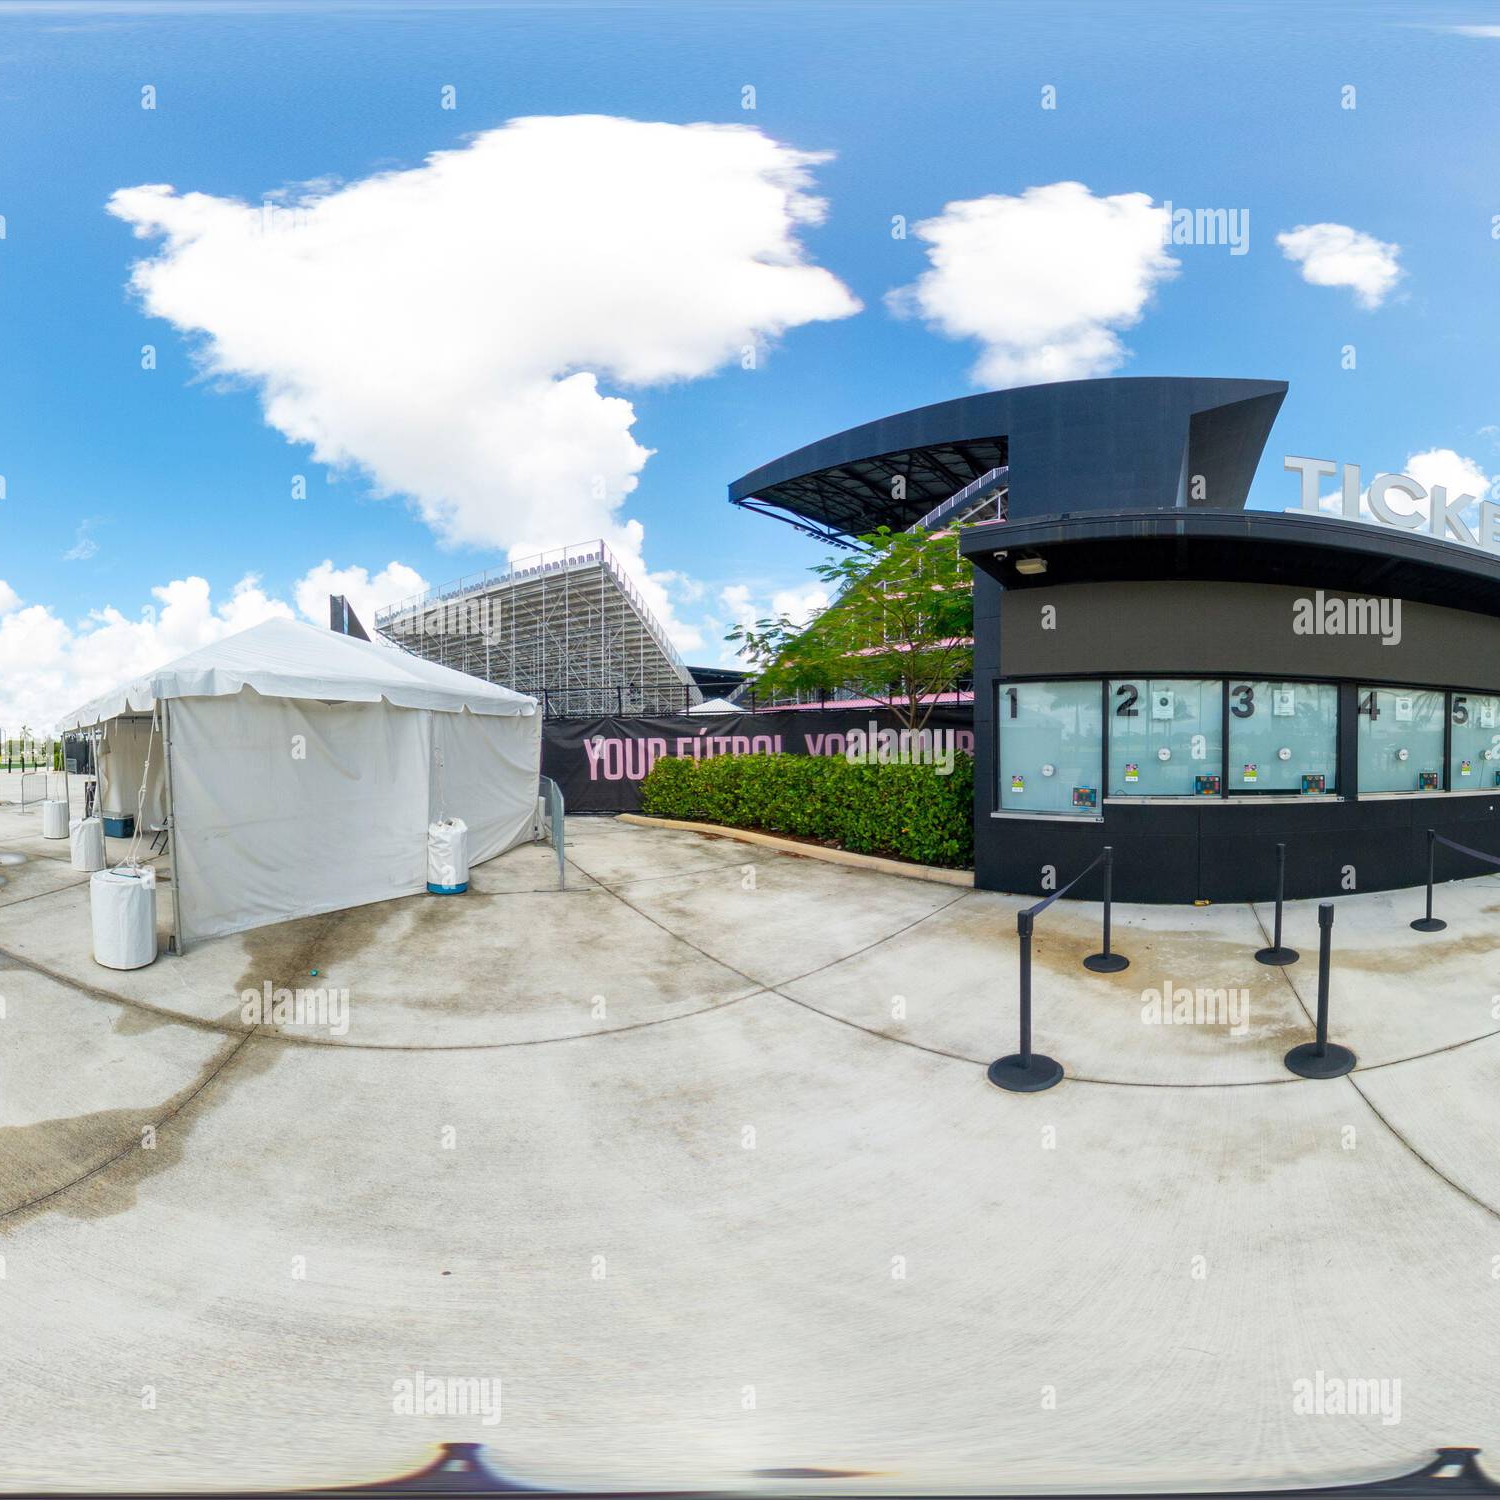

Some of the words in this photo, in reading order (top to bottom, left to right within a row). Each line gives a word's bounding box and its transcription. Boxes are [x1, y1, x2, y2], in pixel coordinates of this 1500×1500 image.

[1006, 688, 1017, 718] 1
[1116, 684, 1138, 716] 2
[1231, 685, 1254, 718] 3
[1358, 692, 1380, 720] 4
[1453, 697, 1468, 724] 5
